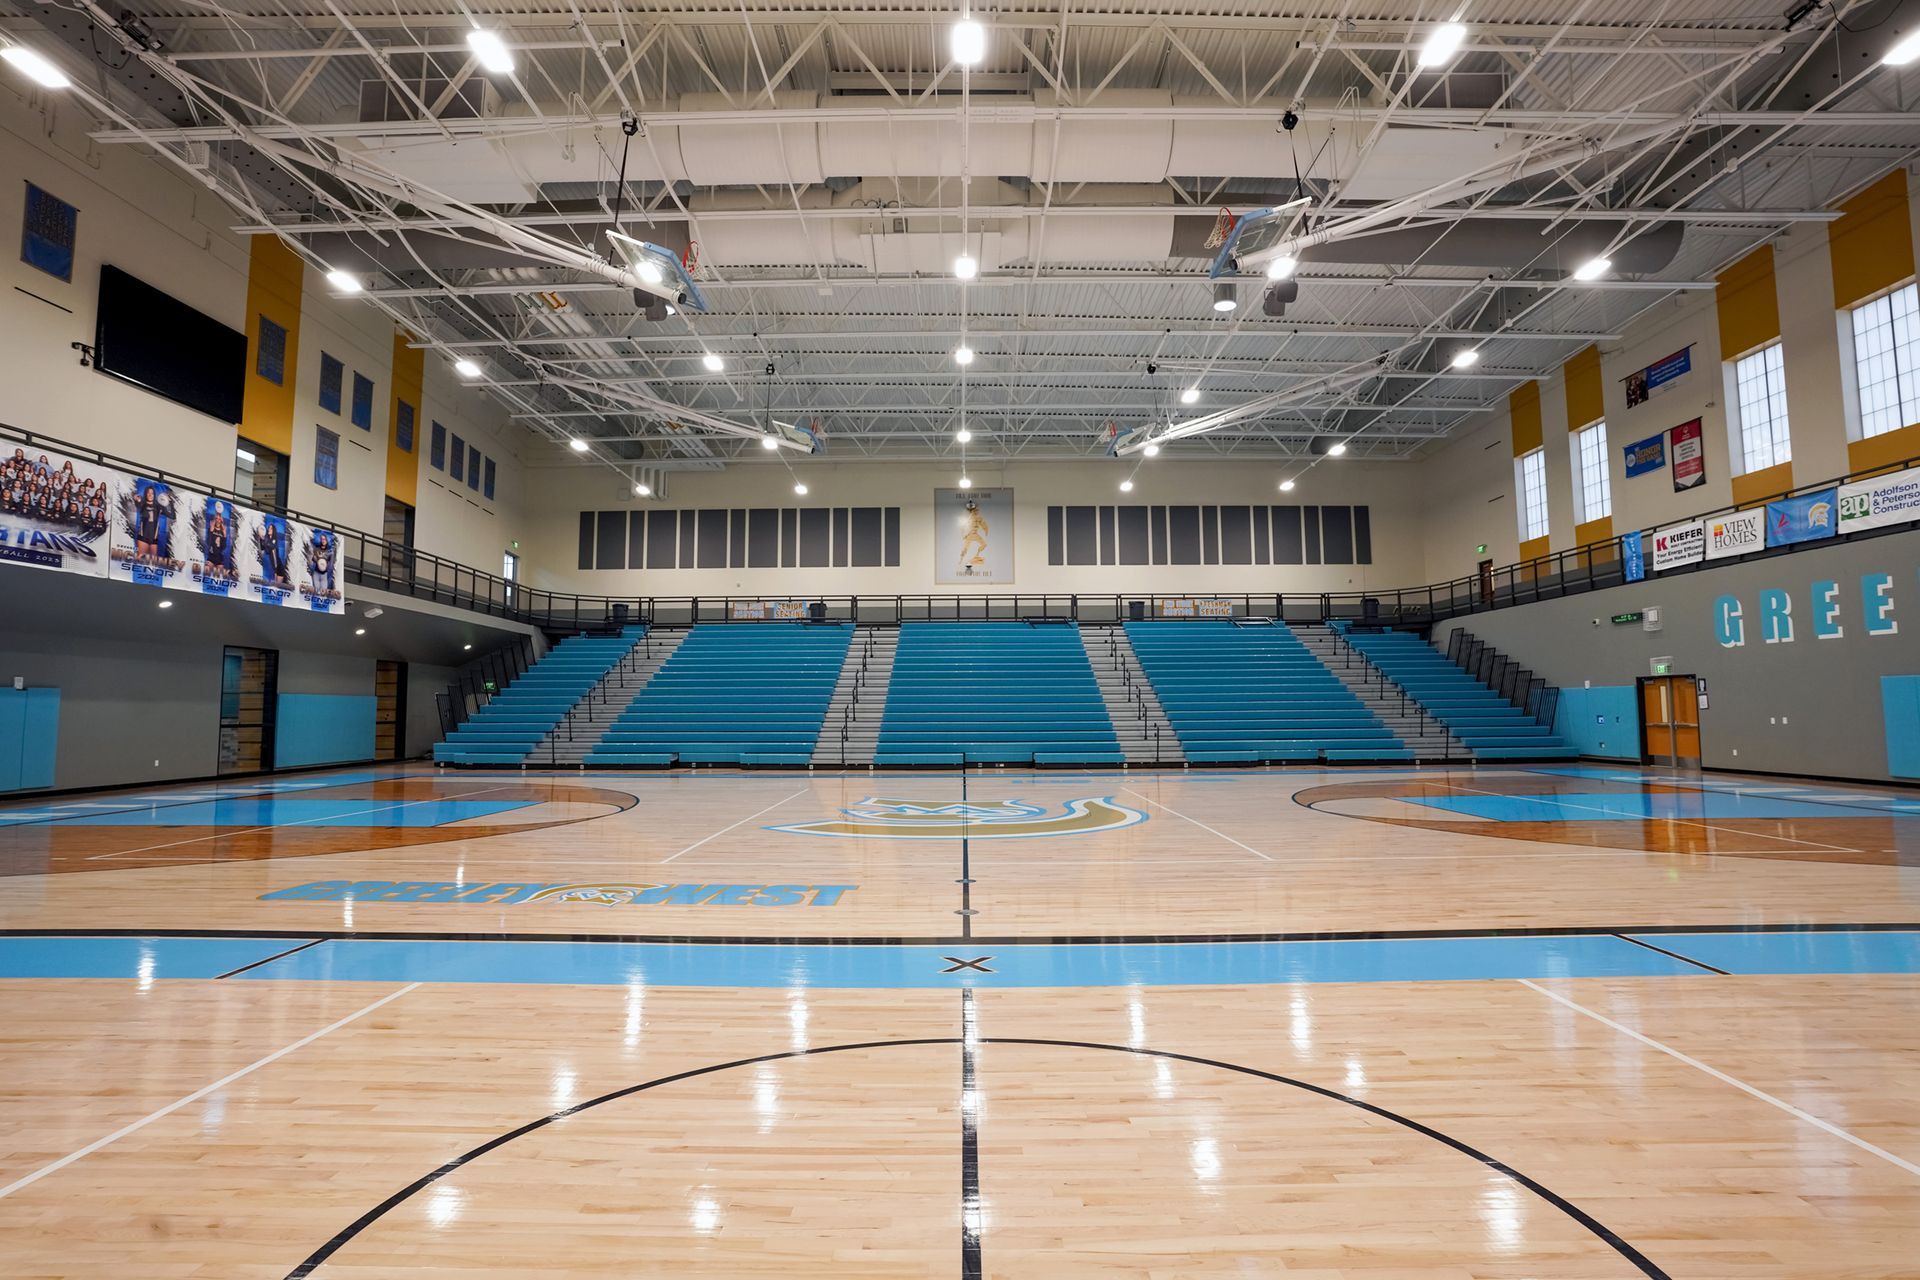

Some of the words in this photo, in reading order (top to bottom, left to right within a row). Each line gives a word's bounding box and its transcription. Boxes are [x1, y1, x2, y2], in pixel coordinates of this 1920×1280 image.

[1872, 483, 1918, 498] Adolfson
[1872, 498, 1880, 506] &
[1882, 491, 1920, 504] Peterso
[1873, 500, 1920, 514] Construc
[1724, 518, 1755, 534] VIEW
[1670, 527, 1704, 543] KIEFER
[1714, 529, 1757, 548] HOMES
[193, 575, 238, 588] SENIOR
[1201, 608, 1230, 616] SEATING
[1713, 566, 1920, 648] GREE
[626, 884, 860, 906] WEST
